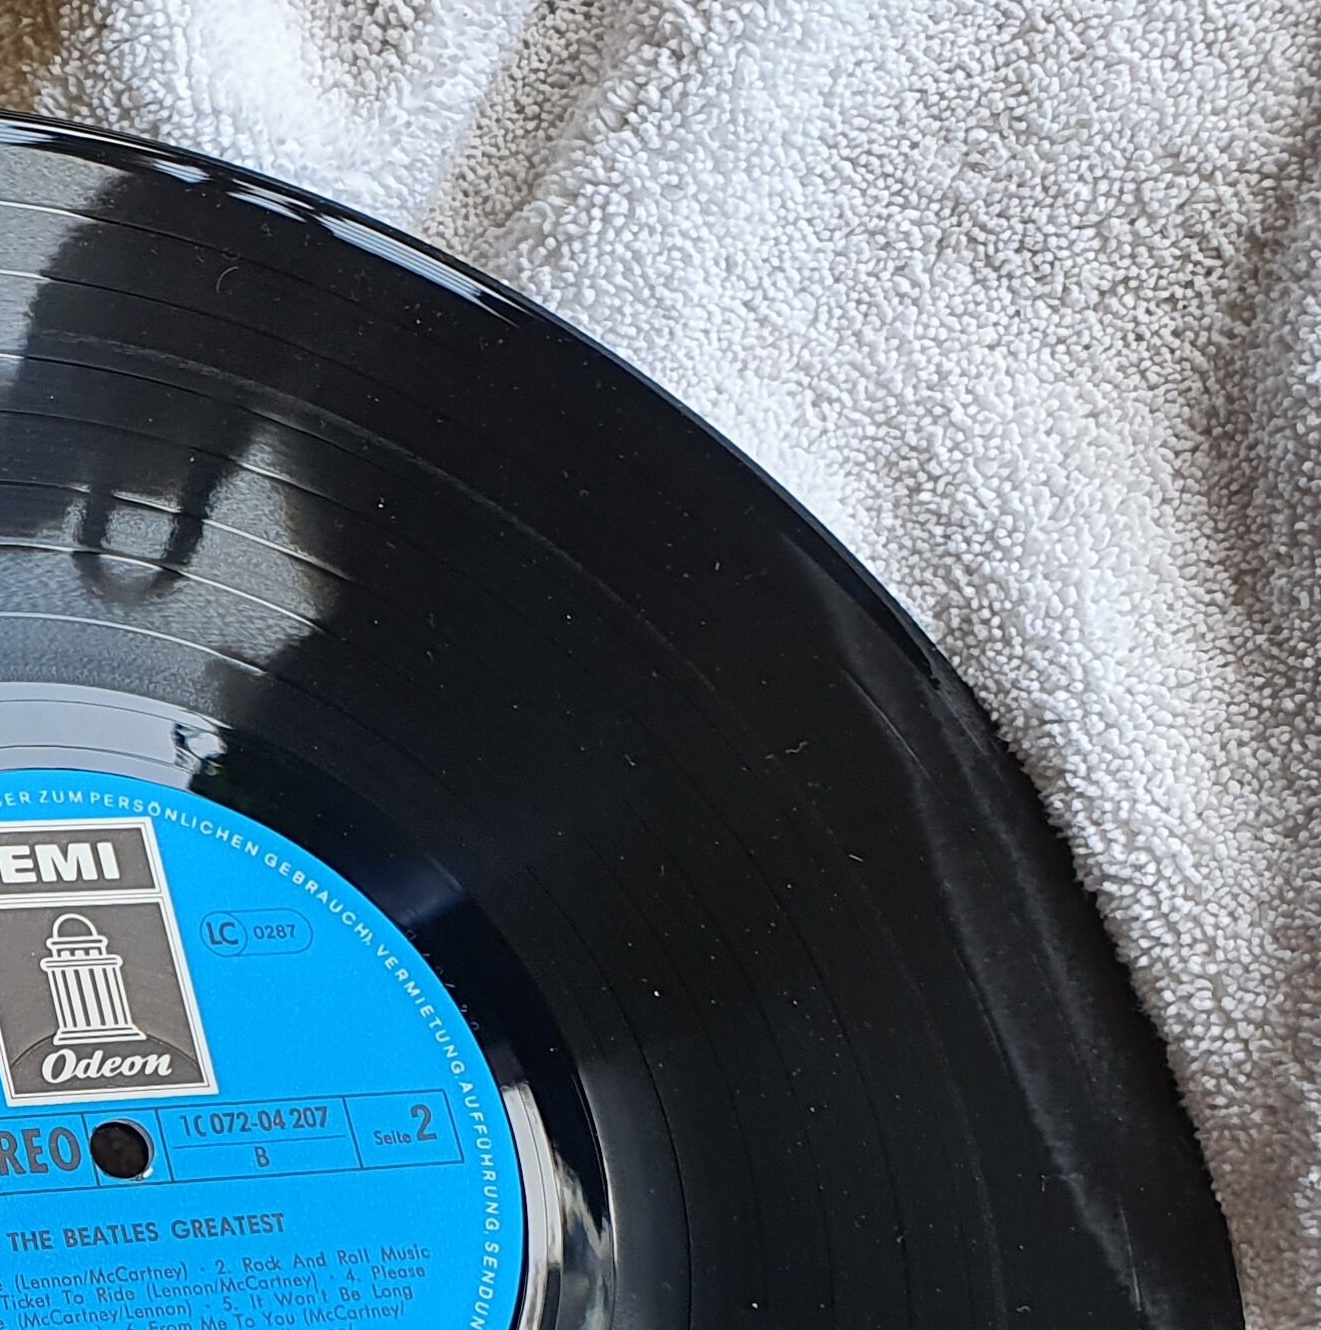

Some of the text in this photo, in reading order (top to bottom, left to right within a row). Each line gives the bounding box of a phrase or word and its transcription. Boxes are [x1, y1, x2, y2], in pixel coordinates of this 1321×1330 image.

[39, 790, 83, 804] ZUM
[90, 793, 260, 857] PERSÖNLICHEN
[206, 922, 296, 945] LC 0287
[41, 1048, 172, 1084] Odeon
[373, 1103, 437, 1146] Seite 2
[254, 1146, 270, 1168] B
[6, 1213, 286, 1252] THE BEATLES GREATEST
[14, 1261, 188, 1293] (Lennon/McCartney)
[215, 1260, 231, 1275] 2.
[243, 1255, 280, 1274] Rock
[293, 1251, 327, 1269] And
[337, 1248, 370, 1266] Roll
[380, 1244, 430, 1262] Music
[0, 1293, 52, 1311] Ticket
[62, 1290, 84, 1305] To
[97, 1287, 135, 1304] Ride
[146, 1272, 319, 1302] (Lennon/McCartney)
[345, 1266, 361, 1283] 4.
[371, 1264, 426, 1281] Please
[223, 1297, 239, 1312] 5.
[250, 1294, 263, 1309] It
[277, 1289, 328, 1308] Won't
[339, 1286, 361, 1302] Be
[372, 1283, 414, 1301] Long
[234, 1313, 255, 1329] To
[265, 1311, 295, 1328] You
[303, 1301, 406, 1327] (McCartney/
